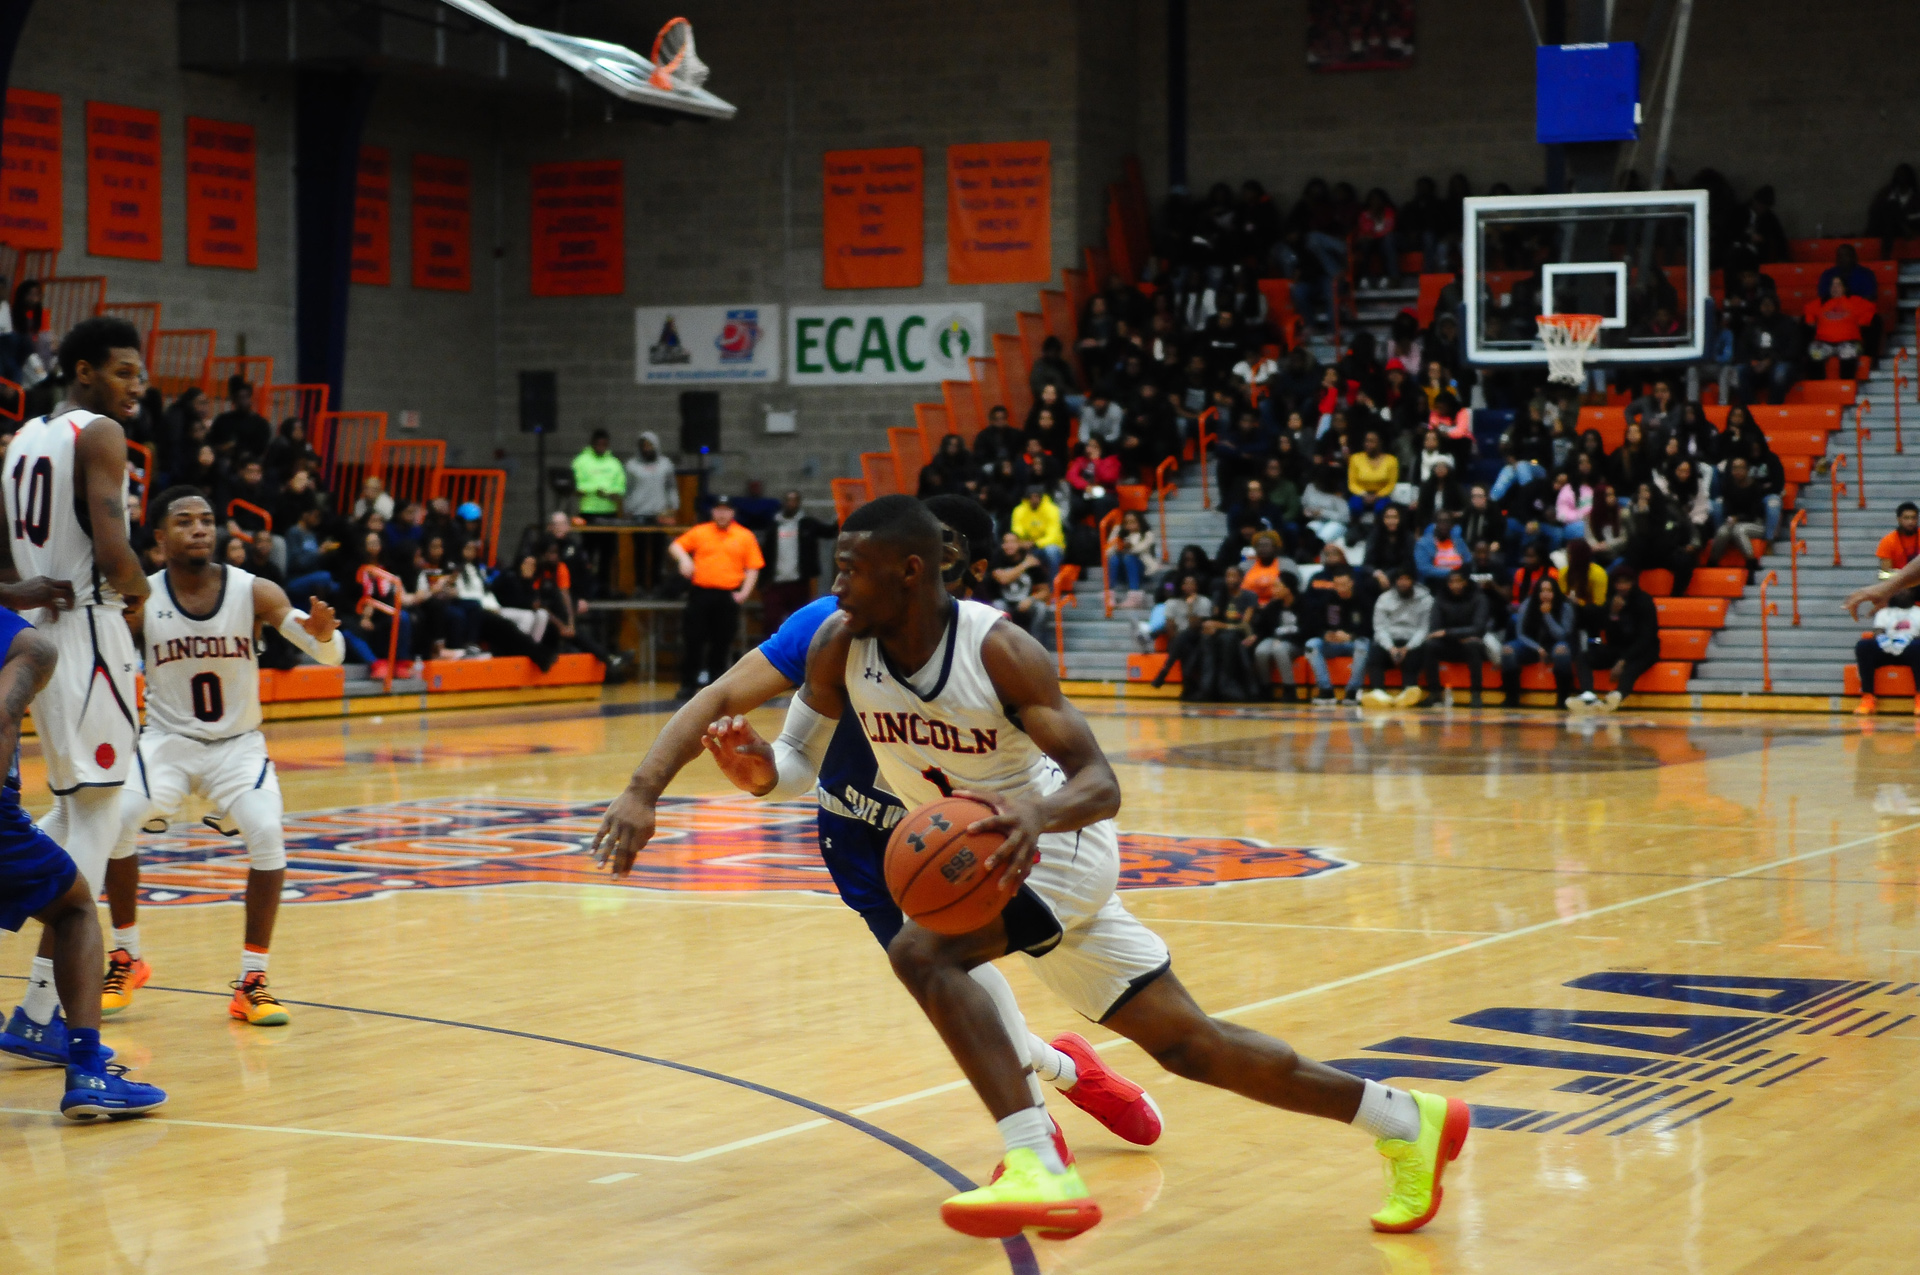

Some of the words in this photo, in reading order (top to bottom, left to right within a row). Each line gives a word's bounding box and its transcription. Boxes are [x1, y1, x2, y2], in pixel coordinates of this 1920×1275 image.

[795, 315, 926, 373] ECAC
[11, 455, 53, 547] 10
[153, 636, 252, 667] LINCOLN
[190, 671, 224, 722] 0
[859, 712, 997, 754] LINCOLN
